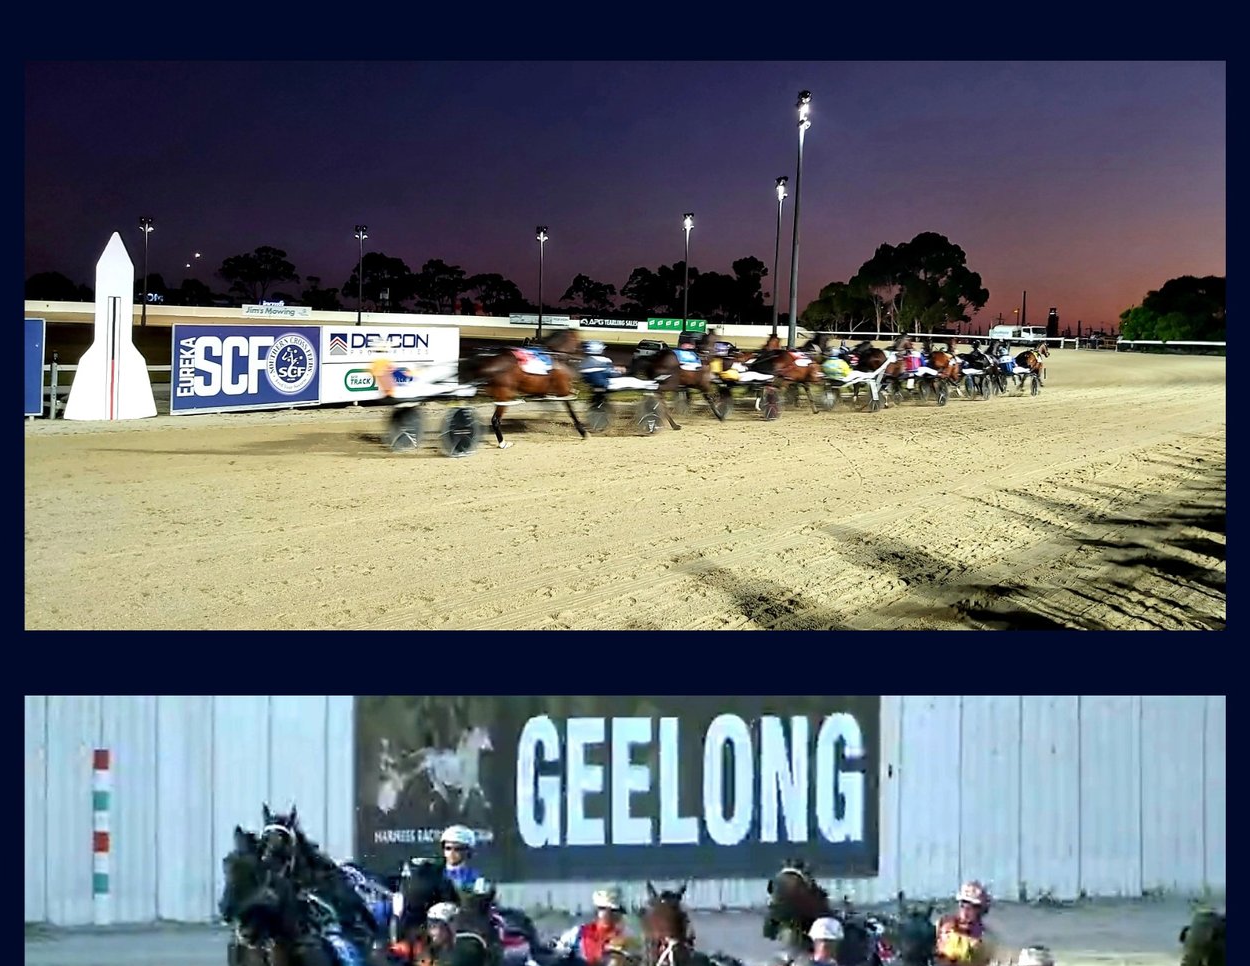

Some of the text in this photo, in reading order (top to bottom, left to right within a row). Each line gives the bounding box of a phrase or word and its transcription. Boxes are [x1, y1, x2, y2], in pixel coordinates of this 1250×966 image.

[266, 307, 296, 316] Mowing
[176, 336, 197, 397] EUREKA
[194, 335, 275, 397] SCF
[278, 366, 306, 378] SCF
[350, 377, 371, 385] TRACK
[516, 711, 865, 849] GEELONG
